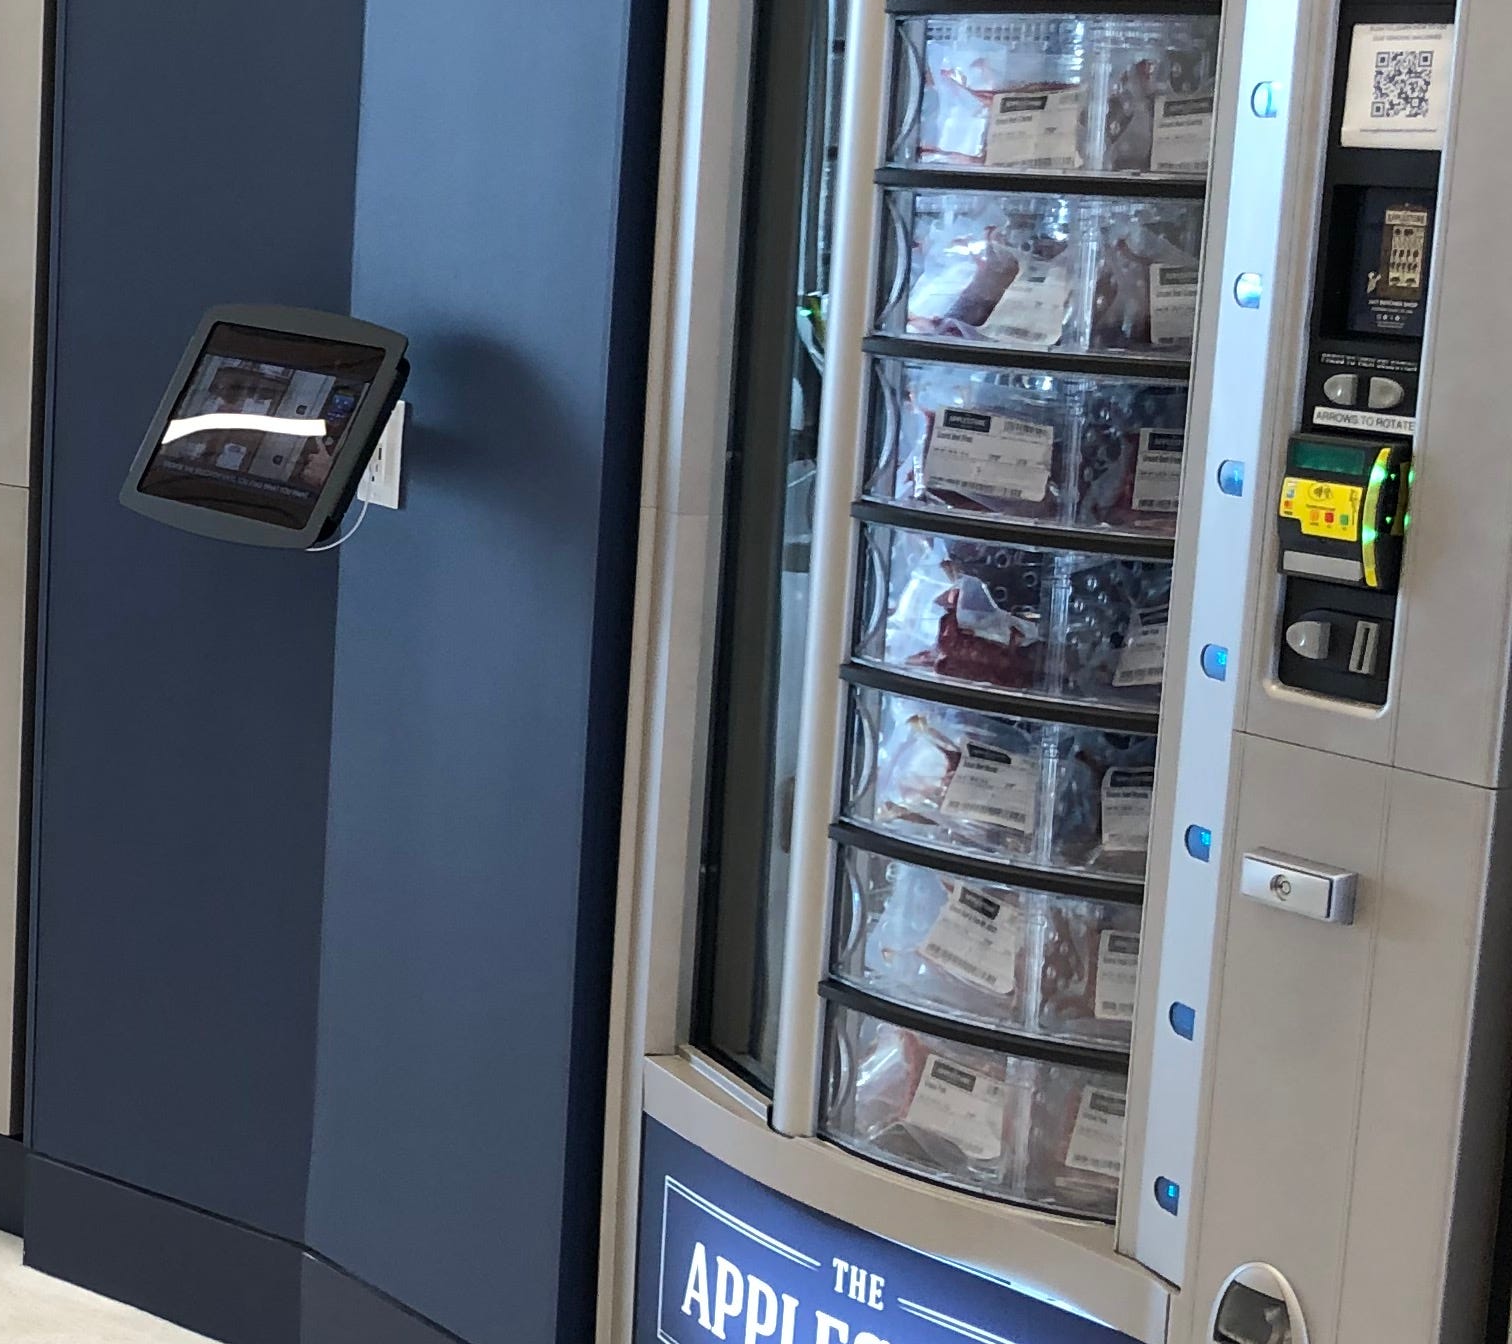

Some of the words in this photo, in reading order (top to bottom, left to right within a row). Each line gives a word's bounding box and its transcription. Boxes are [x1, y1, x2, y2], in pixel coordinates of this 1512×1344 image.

[1316, 411, 1359, 425] ARROWS
[1361, 416, 1375, 426] TO
[1376, 417, 1416, 431] ROTATE
[833, 1257, 884, 1310] THE
